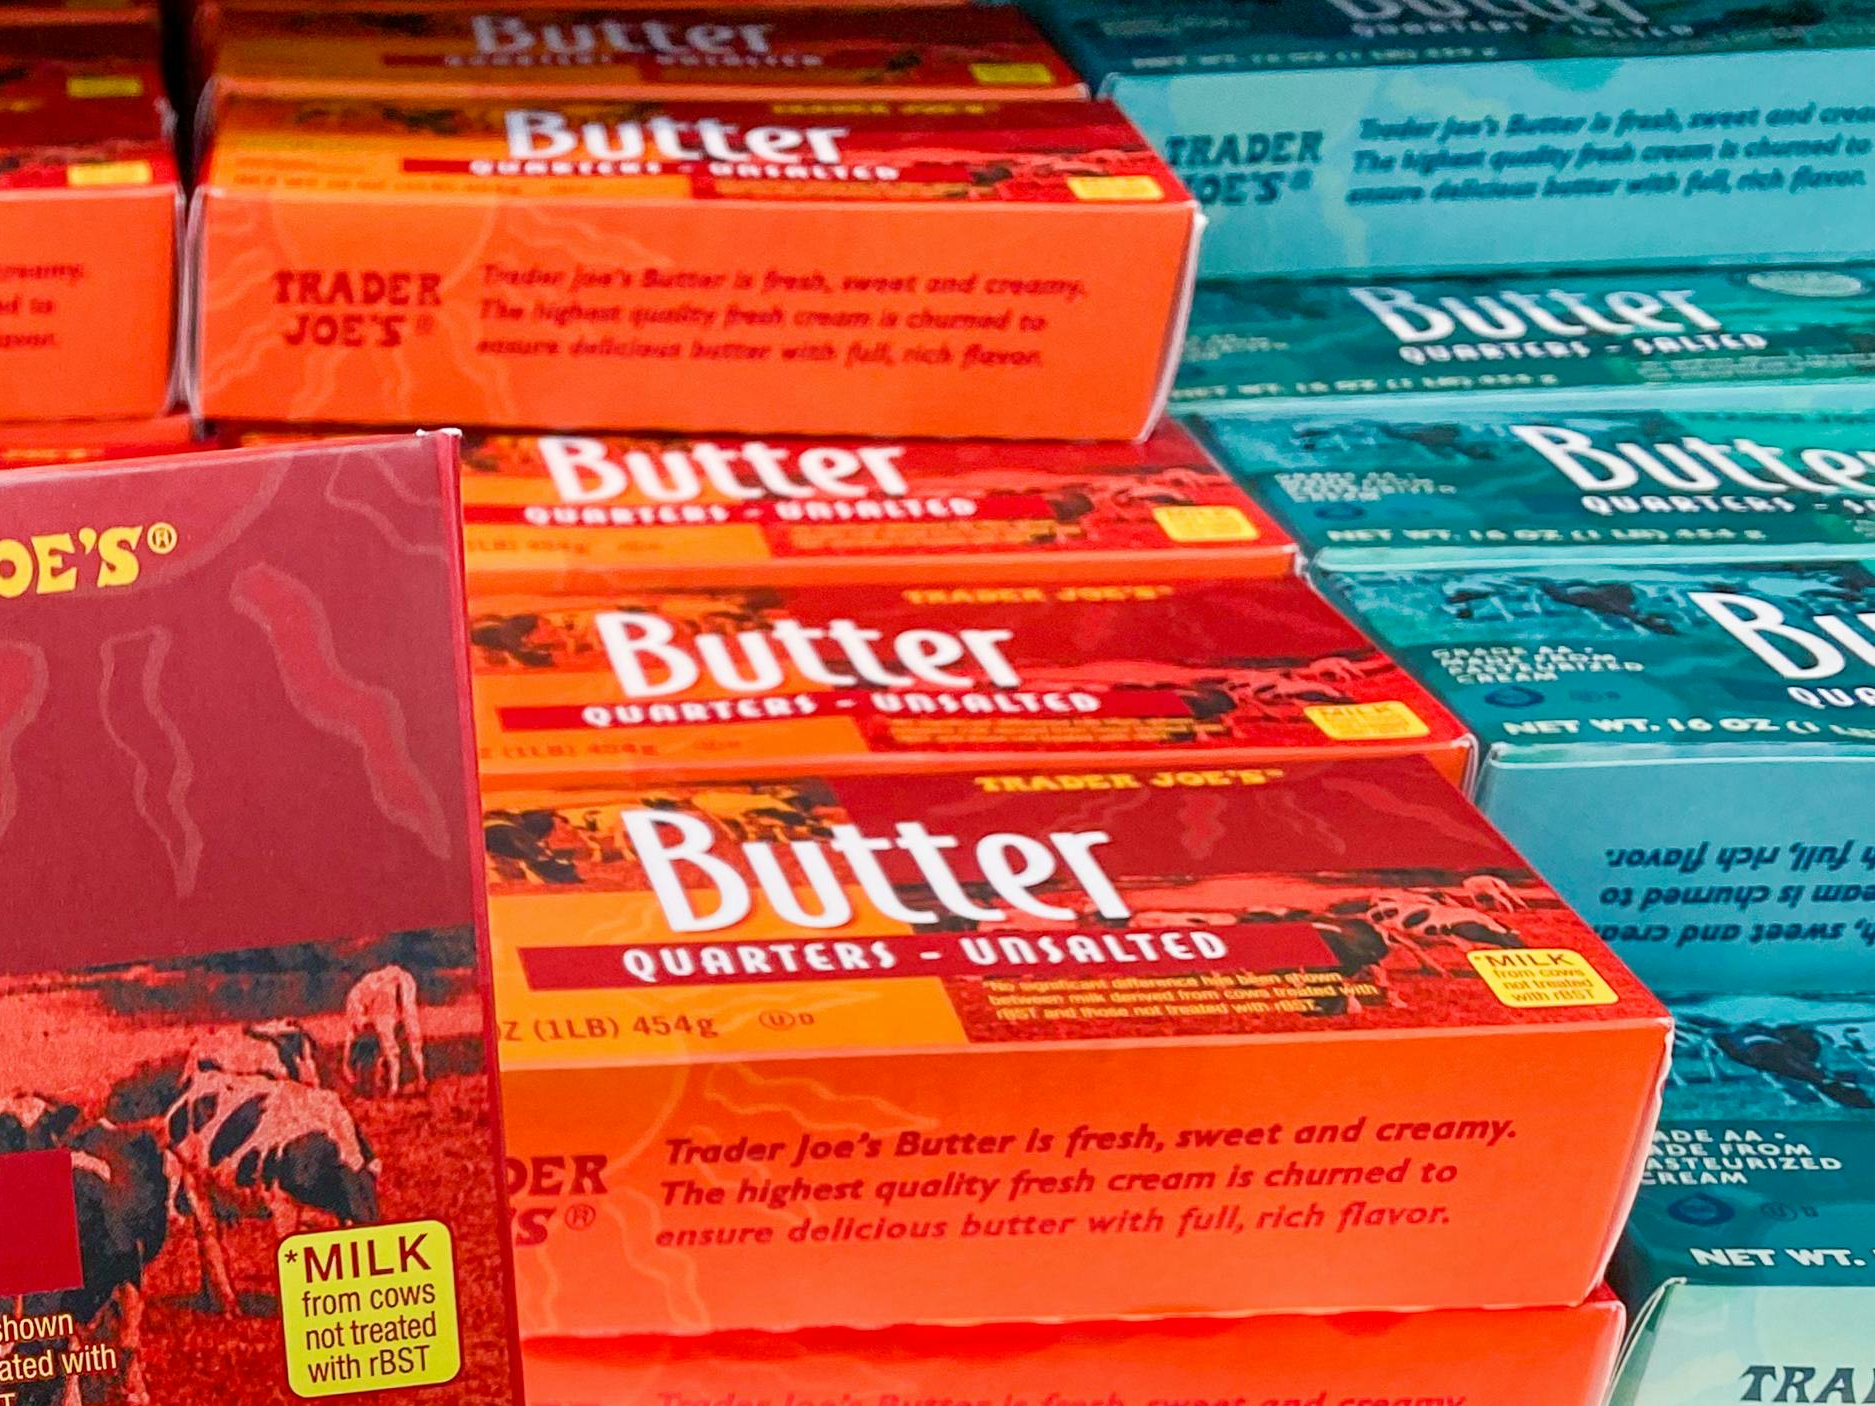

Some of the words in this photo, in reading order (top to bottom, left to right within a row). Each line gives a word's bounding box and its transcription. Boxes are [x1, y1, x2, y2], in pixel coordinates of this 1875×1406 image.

[505, 109, 849, 164] Butter
[274, 270, 444, 306] TRADER
[1350, 287, 1721, 343] Butter
[1400, 341, 1591, 364] QUARTERS
[1633, 334, 1767, 353] SALTED
[538, 436, 908, 503] Butter
[1512, 424, 1875, 494] Butte
[524, 503, 729, 526] QUARTERS
[775, 497, 977, 519] UNSALTED
[1580, 496, 1795, 516] QUARTERS
[595, 610, 1021, 700] Butter
[583, 695, 817, 728] QUARTERS
[871, 692, 1101, 715] UNSALTED
[975, 774, 1142, 793] TRADER
[621, 808, 1130, 934] Butter
[1604, 841, 1711, 874] flavor.
[1716, 846, 1781, 873] rich
[1598, 885, 1633, 911] to
[1675, 923, 1743, 949] and
[623, 940, 896, 982] QUARTERS
[960, 929, 1229, 966] UNSALTED
[534, 1017, 620, 1042] (1LB)
[633, 1015, 718, 1039] 454g
[665, 1136, 785, 1166] Trader
[790, 1133, 882, 1167] Joe's
[894, 1130, 1016, 1158] Butter
[1065, 1123, 1165, 1158] fresh,
[1175, 1124, 1284, 1149] sweet
[1294, 1116, 1367, 1145] and
[1376, 1119, 1517, 1147] creamy.
[1649, 1143, 1708, 1156] ADE
[1719, 1143, 1812, 1156] FROM
[1724, 1129, 1763, 1142] AA
[506, 1154, 608, 1196] DER
[1646, 1157, 1843, 1171] ASTEURIZED
[660, 1180, 725, 1206] The
[737, 1177, 864, 1209] highest
[875, 1171, 1000, 1205] quality
[1008, 1167, 1094, 1201] fresh
[1108, 1170, 1216, 1192] cream
[1264, 1158, 1412, 1186] churned
[1421, 1162, 1458, 1184] to
[655, 1224, 773, 1248] ensure
[788, 1216, 947, 1244] delicious
[960, 1211, 1074, 1238] butter
[1087, 1207, 1165, 1234] with
[1175, 1205, 1244, 1238] full,
[1255, 1203, 1324, 1229] rich
[1337, 1202, 1451, 1234] flavor.
[1689, 1248, 1775, 1267] NET
[1784, 1248, 1867, 1267] WT.
[302, 1290, 361, 1318] from
[369, 1283, 436, 1310] cows
[306, 1325, 345, 1351] not
[349, 1311, 437, 1346] treated
[61, 1344, 117, 1376] with
[307, 1352, 362, 1384] with
[368, 1345, 431, 1378] rBST
[1739, 1365, 1875, 1403] TRA
